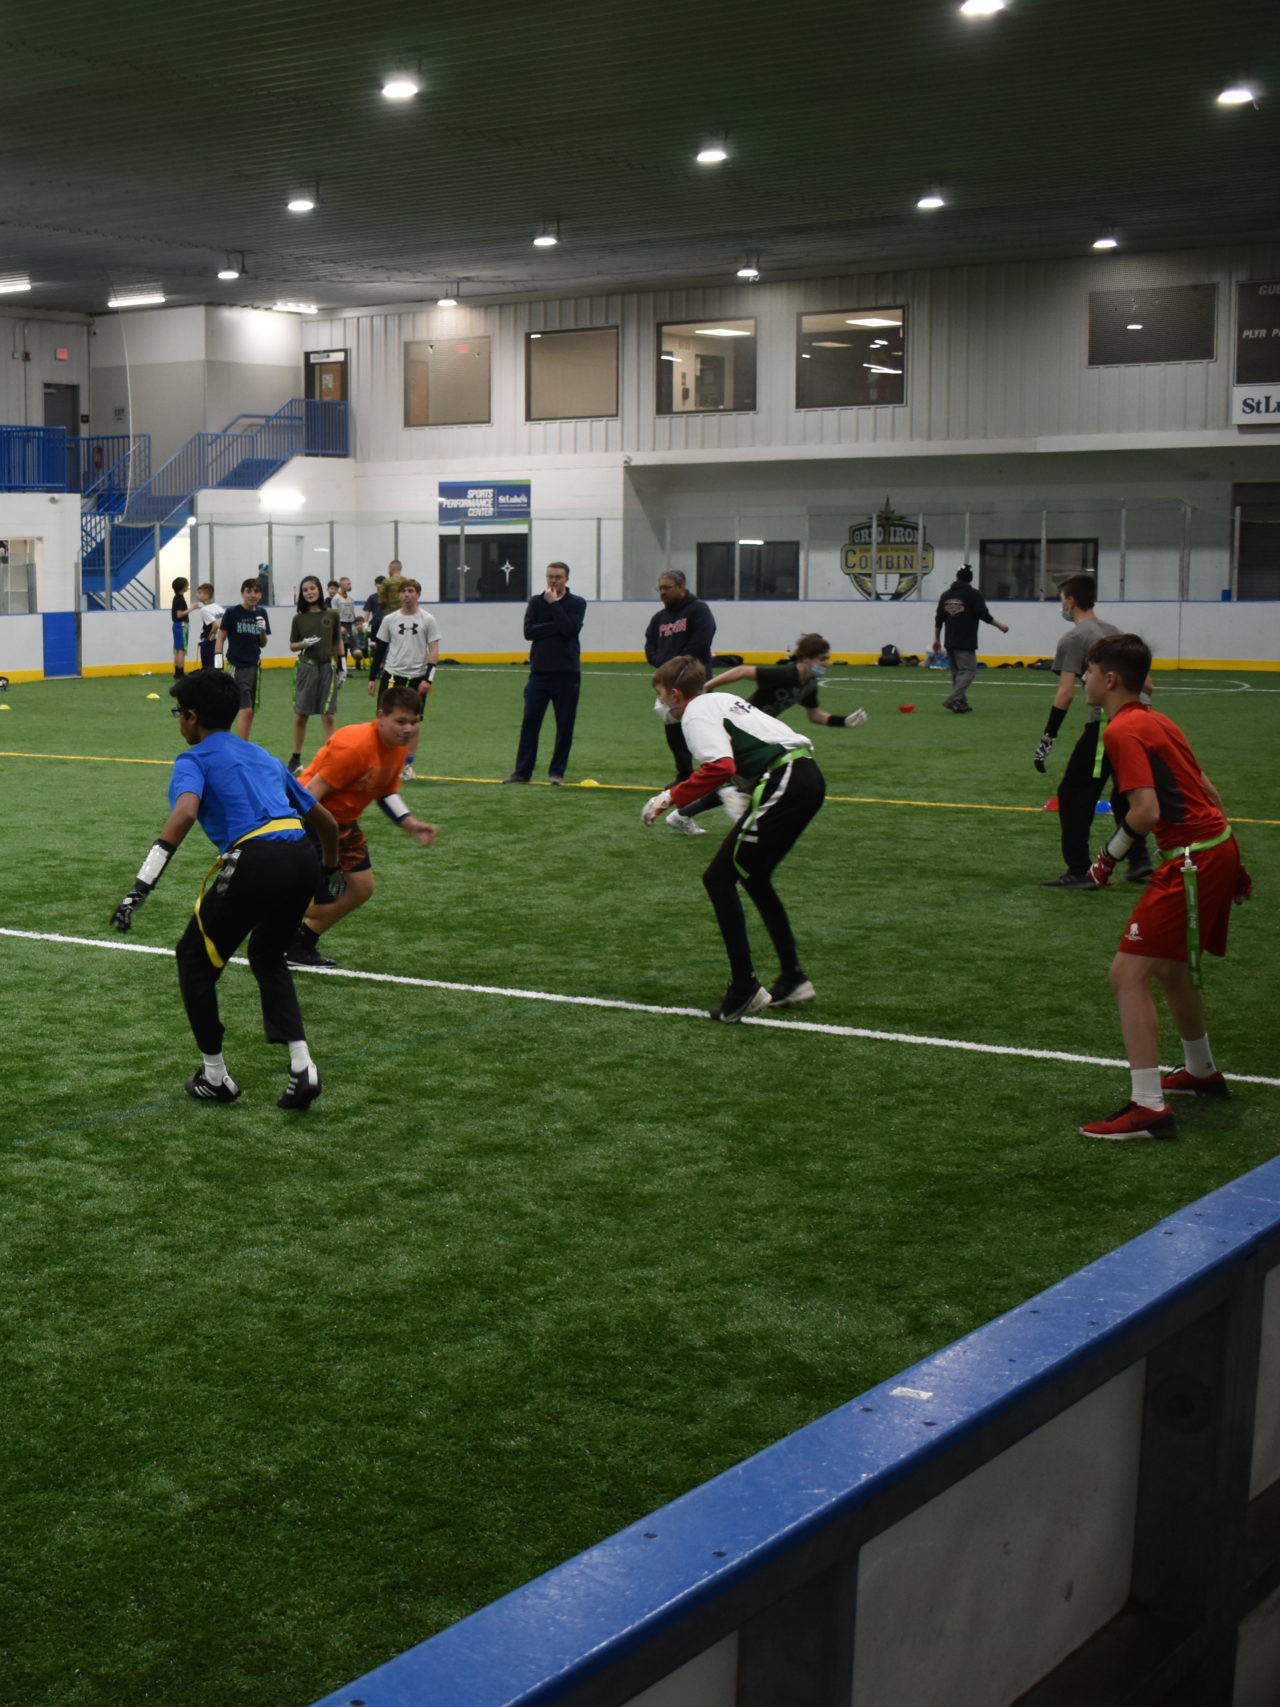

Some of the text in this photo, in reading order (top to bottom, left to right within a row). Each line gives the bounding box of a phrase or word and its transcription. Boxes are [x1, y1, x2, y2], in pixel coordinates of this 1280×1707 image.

[1242, 329, 1267, 339] PLYR
[467, 489, 494, 499] SPORTS
[442, 498, 493, 508] PERFORMANCE
[467, 508, 494, 517] CENTER
[854, 526, 884, 543] GRD
